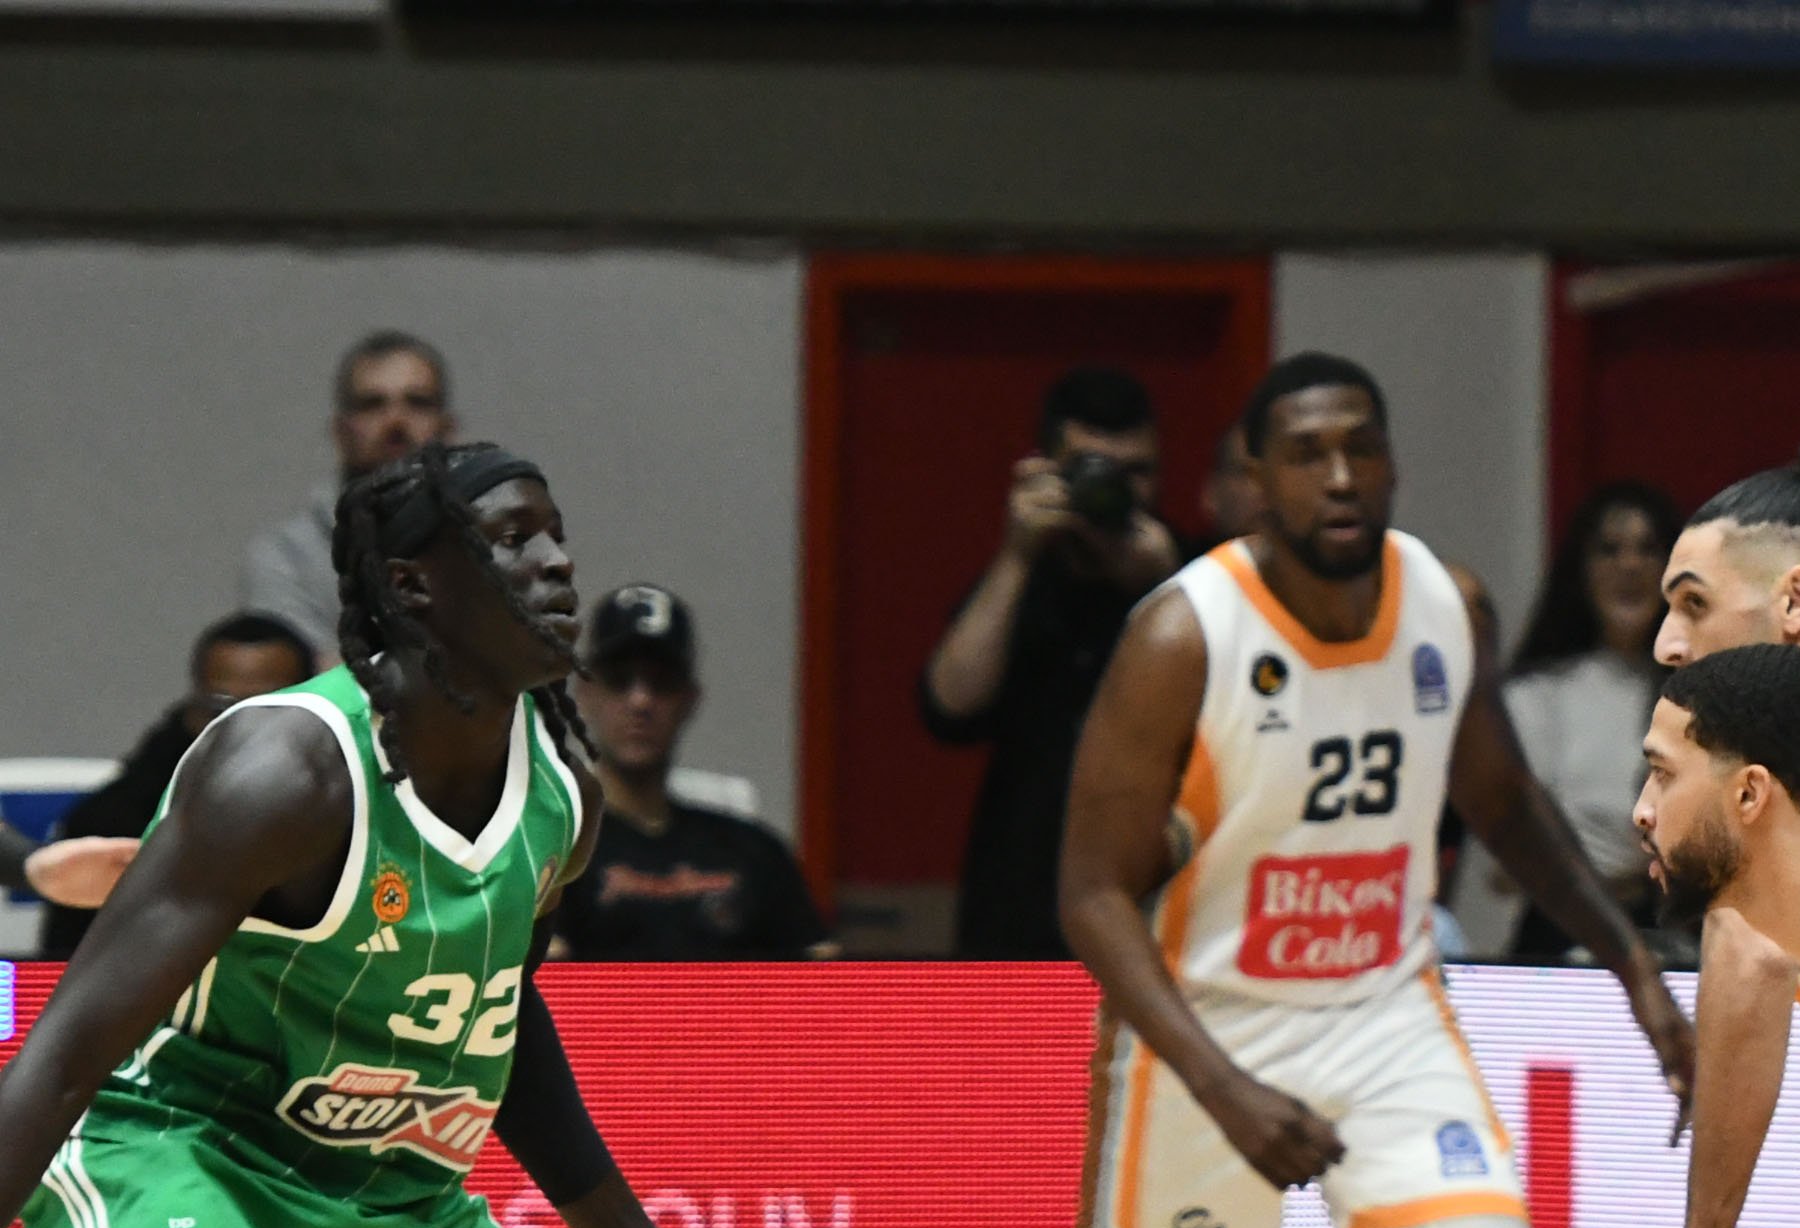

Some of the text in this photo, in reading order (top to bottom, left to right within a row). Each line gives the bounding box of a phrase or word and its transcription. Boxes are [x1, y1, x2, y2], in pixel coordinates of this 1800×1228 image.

[1303, 730, 1403, 822] 23
[1266, 922, 1382, 971] Cola
[386, 964, 523, 1058] 32
